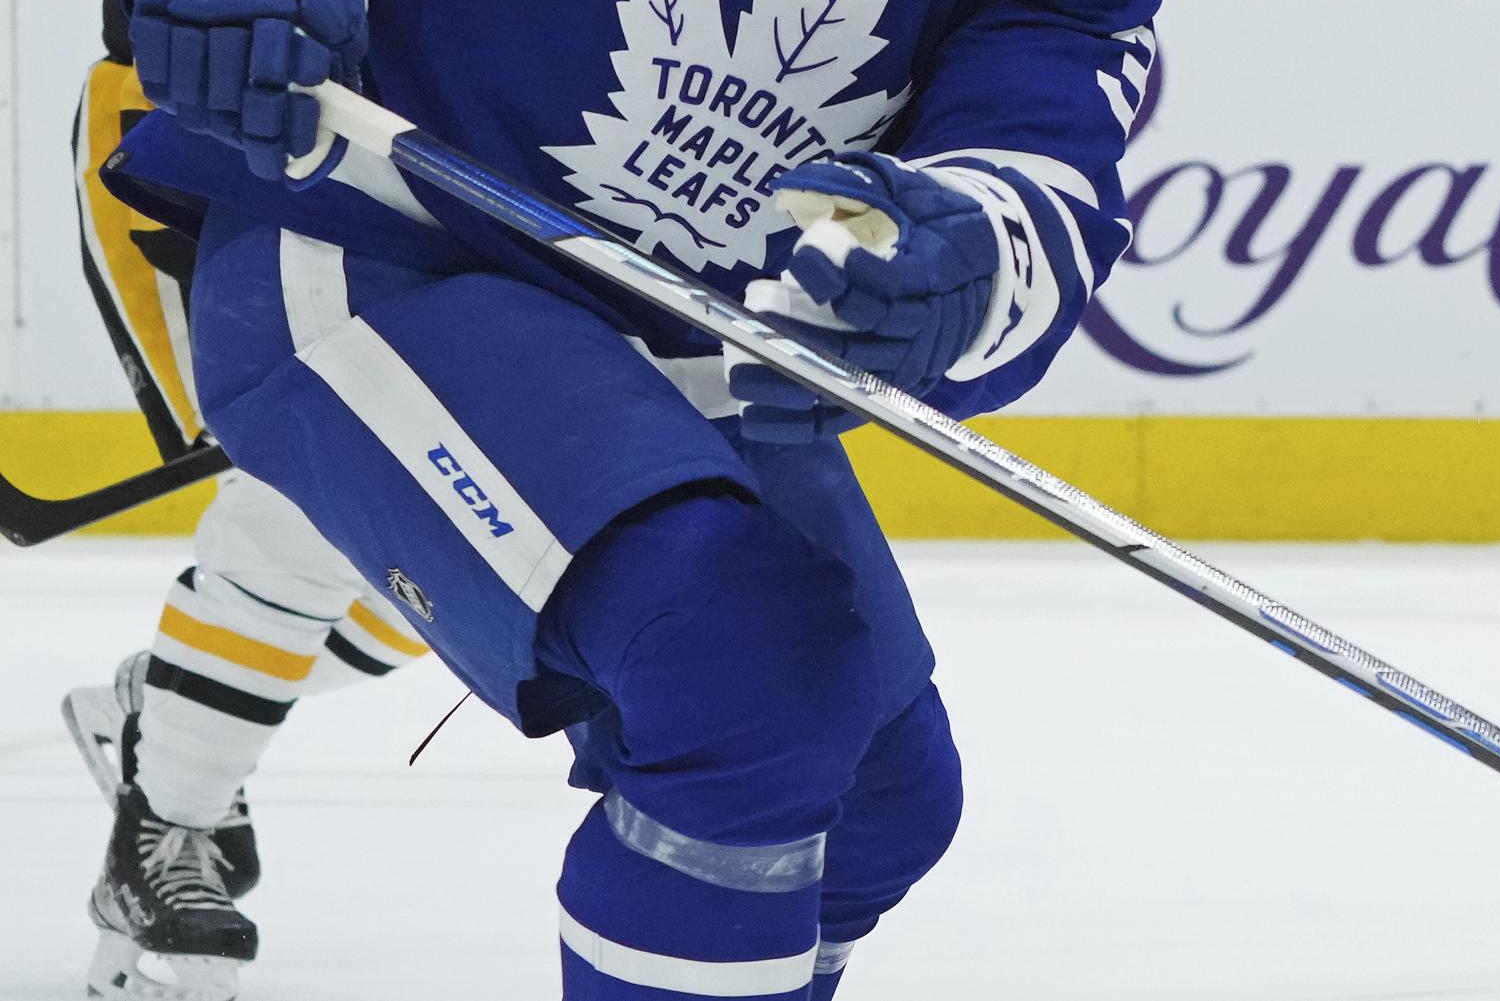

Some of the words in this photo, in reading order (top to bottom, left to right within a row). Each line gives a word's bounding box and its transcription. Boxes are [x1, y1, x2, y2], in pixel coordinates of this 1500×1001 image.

[622, 139, 762, 229] LEAFS
[650, 103, 788, 198] MAPLE
[426, 440, 516, 539] CCM
